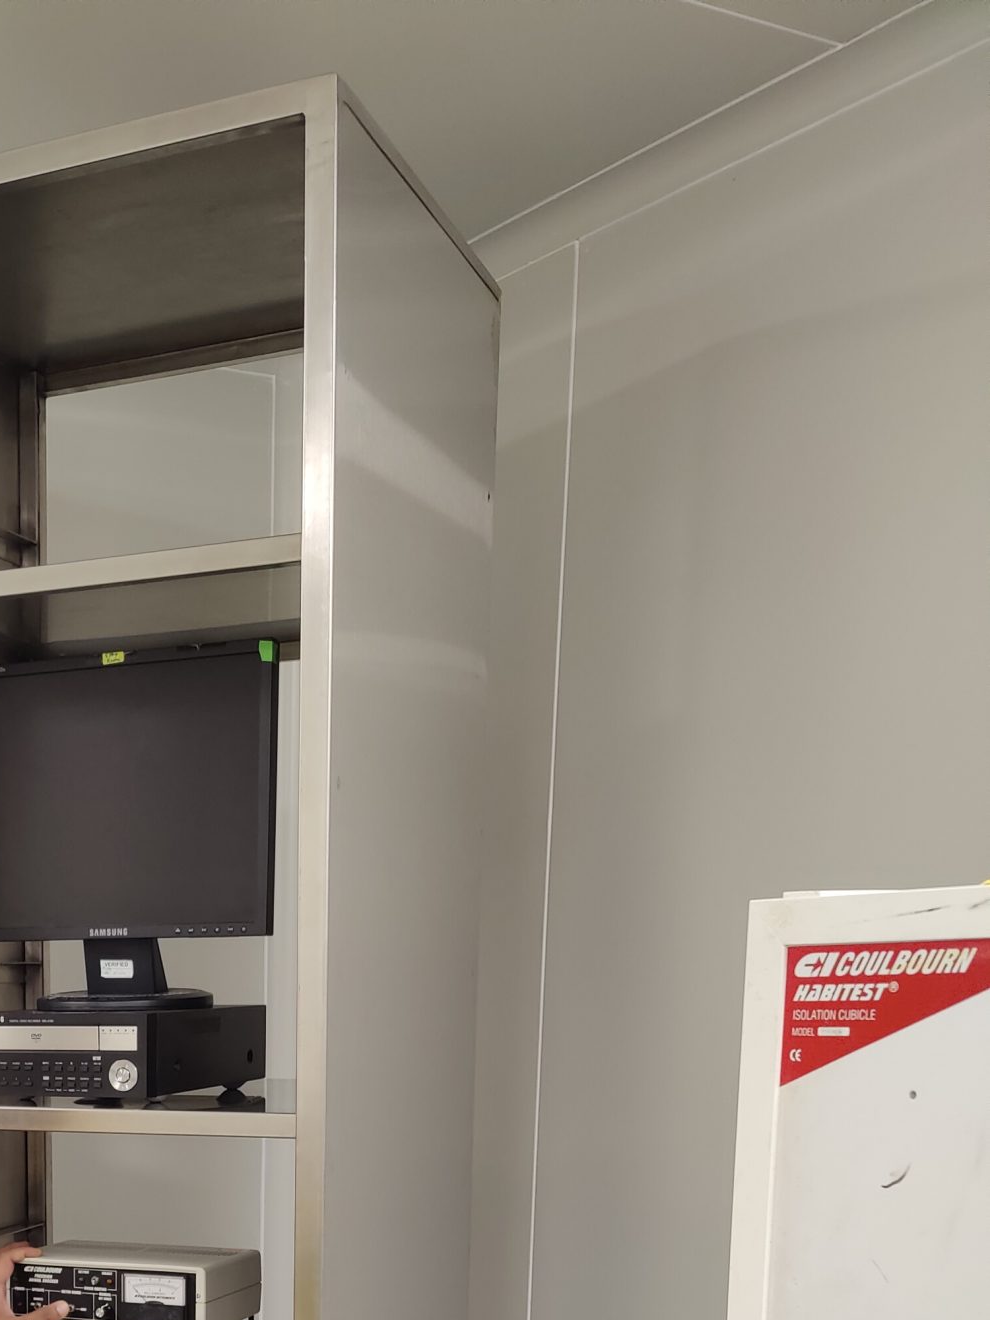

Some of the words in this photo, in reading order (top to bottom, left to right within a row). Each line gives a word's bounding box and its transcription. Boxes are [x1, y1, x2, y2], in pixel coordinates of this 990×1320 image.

[89, 927, 128, 937] SAMSUNG
[835, 947, 978, 977] COULBOURN
[792, 1009, 837, 1020] ISOLATION
[838, 1009, 876, 1020] CUBICLE
[791, 1027, 815, 1037] MODEL
